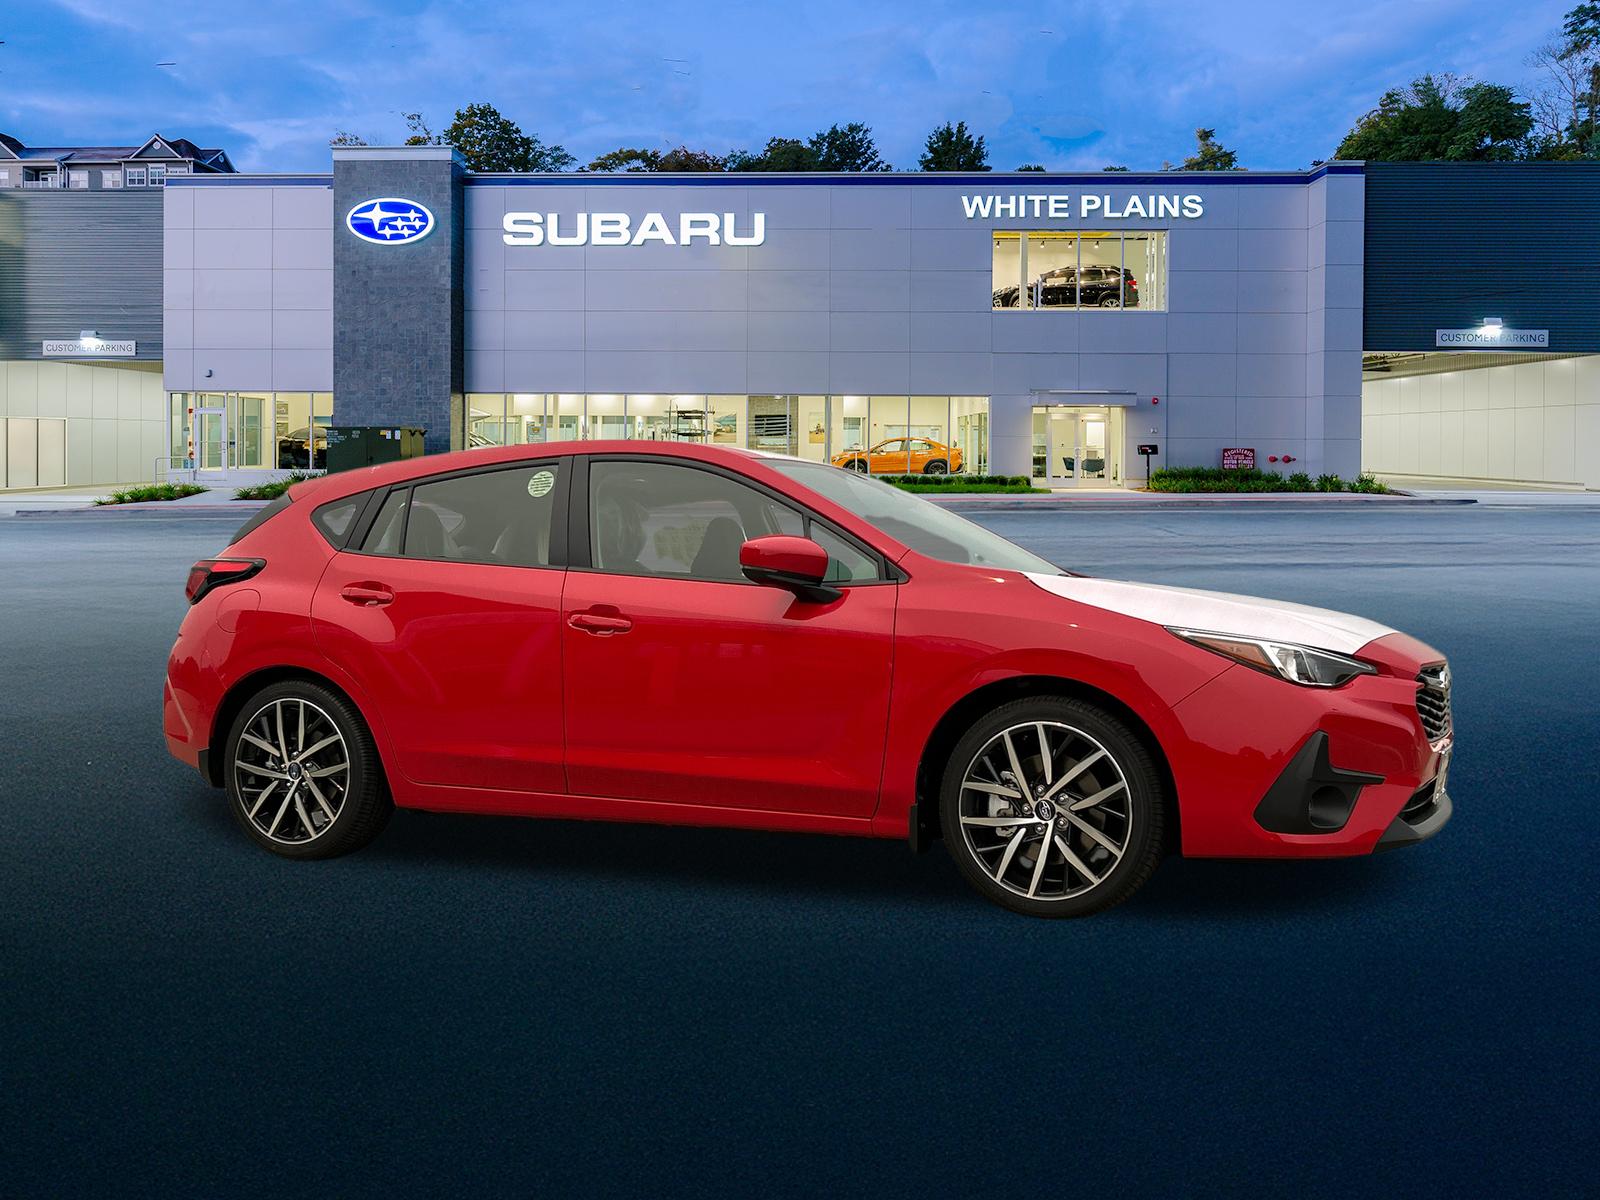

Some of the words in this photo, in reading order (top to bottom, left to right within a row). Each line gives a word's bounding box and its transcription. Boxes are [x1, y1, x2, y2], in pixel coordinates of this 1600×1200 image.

[961, 195, 1070, 218] WHITE
[1080, 195, 1204, 218] PLAINS
[502, 212, 765, 246] SUBARU
[1440, 333, 1496, 342] CUSTOMER
[1498, 333, 1545, 342] PARKING
[45, 344, 92, 352] CUSTOMER
[94, 344, 132, 352] PARKING
